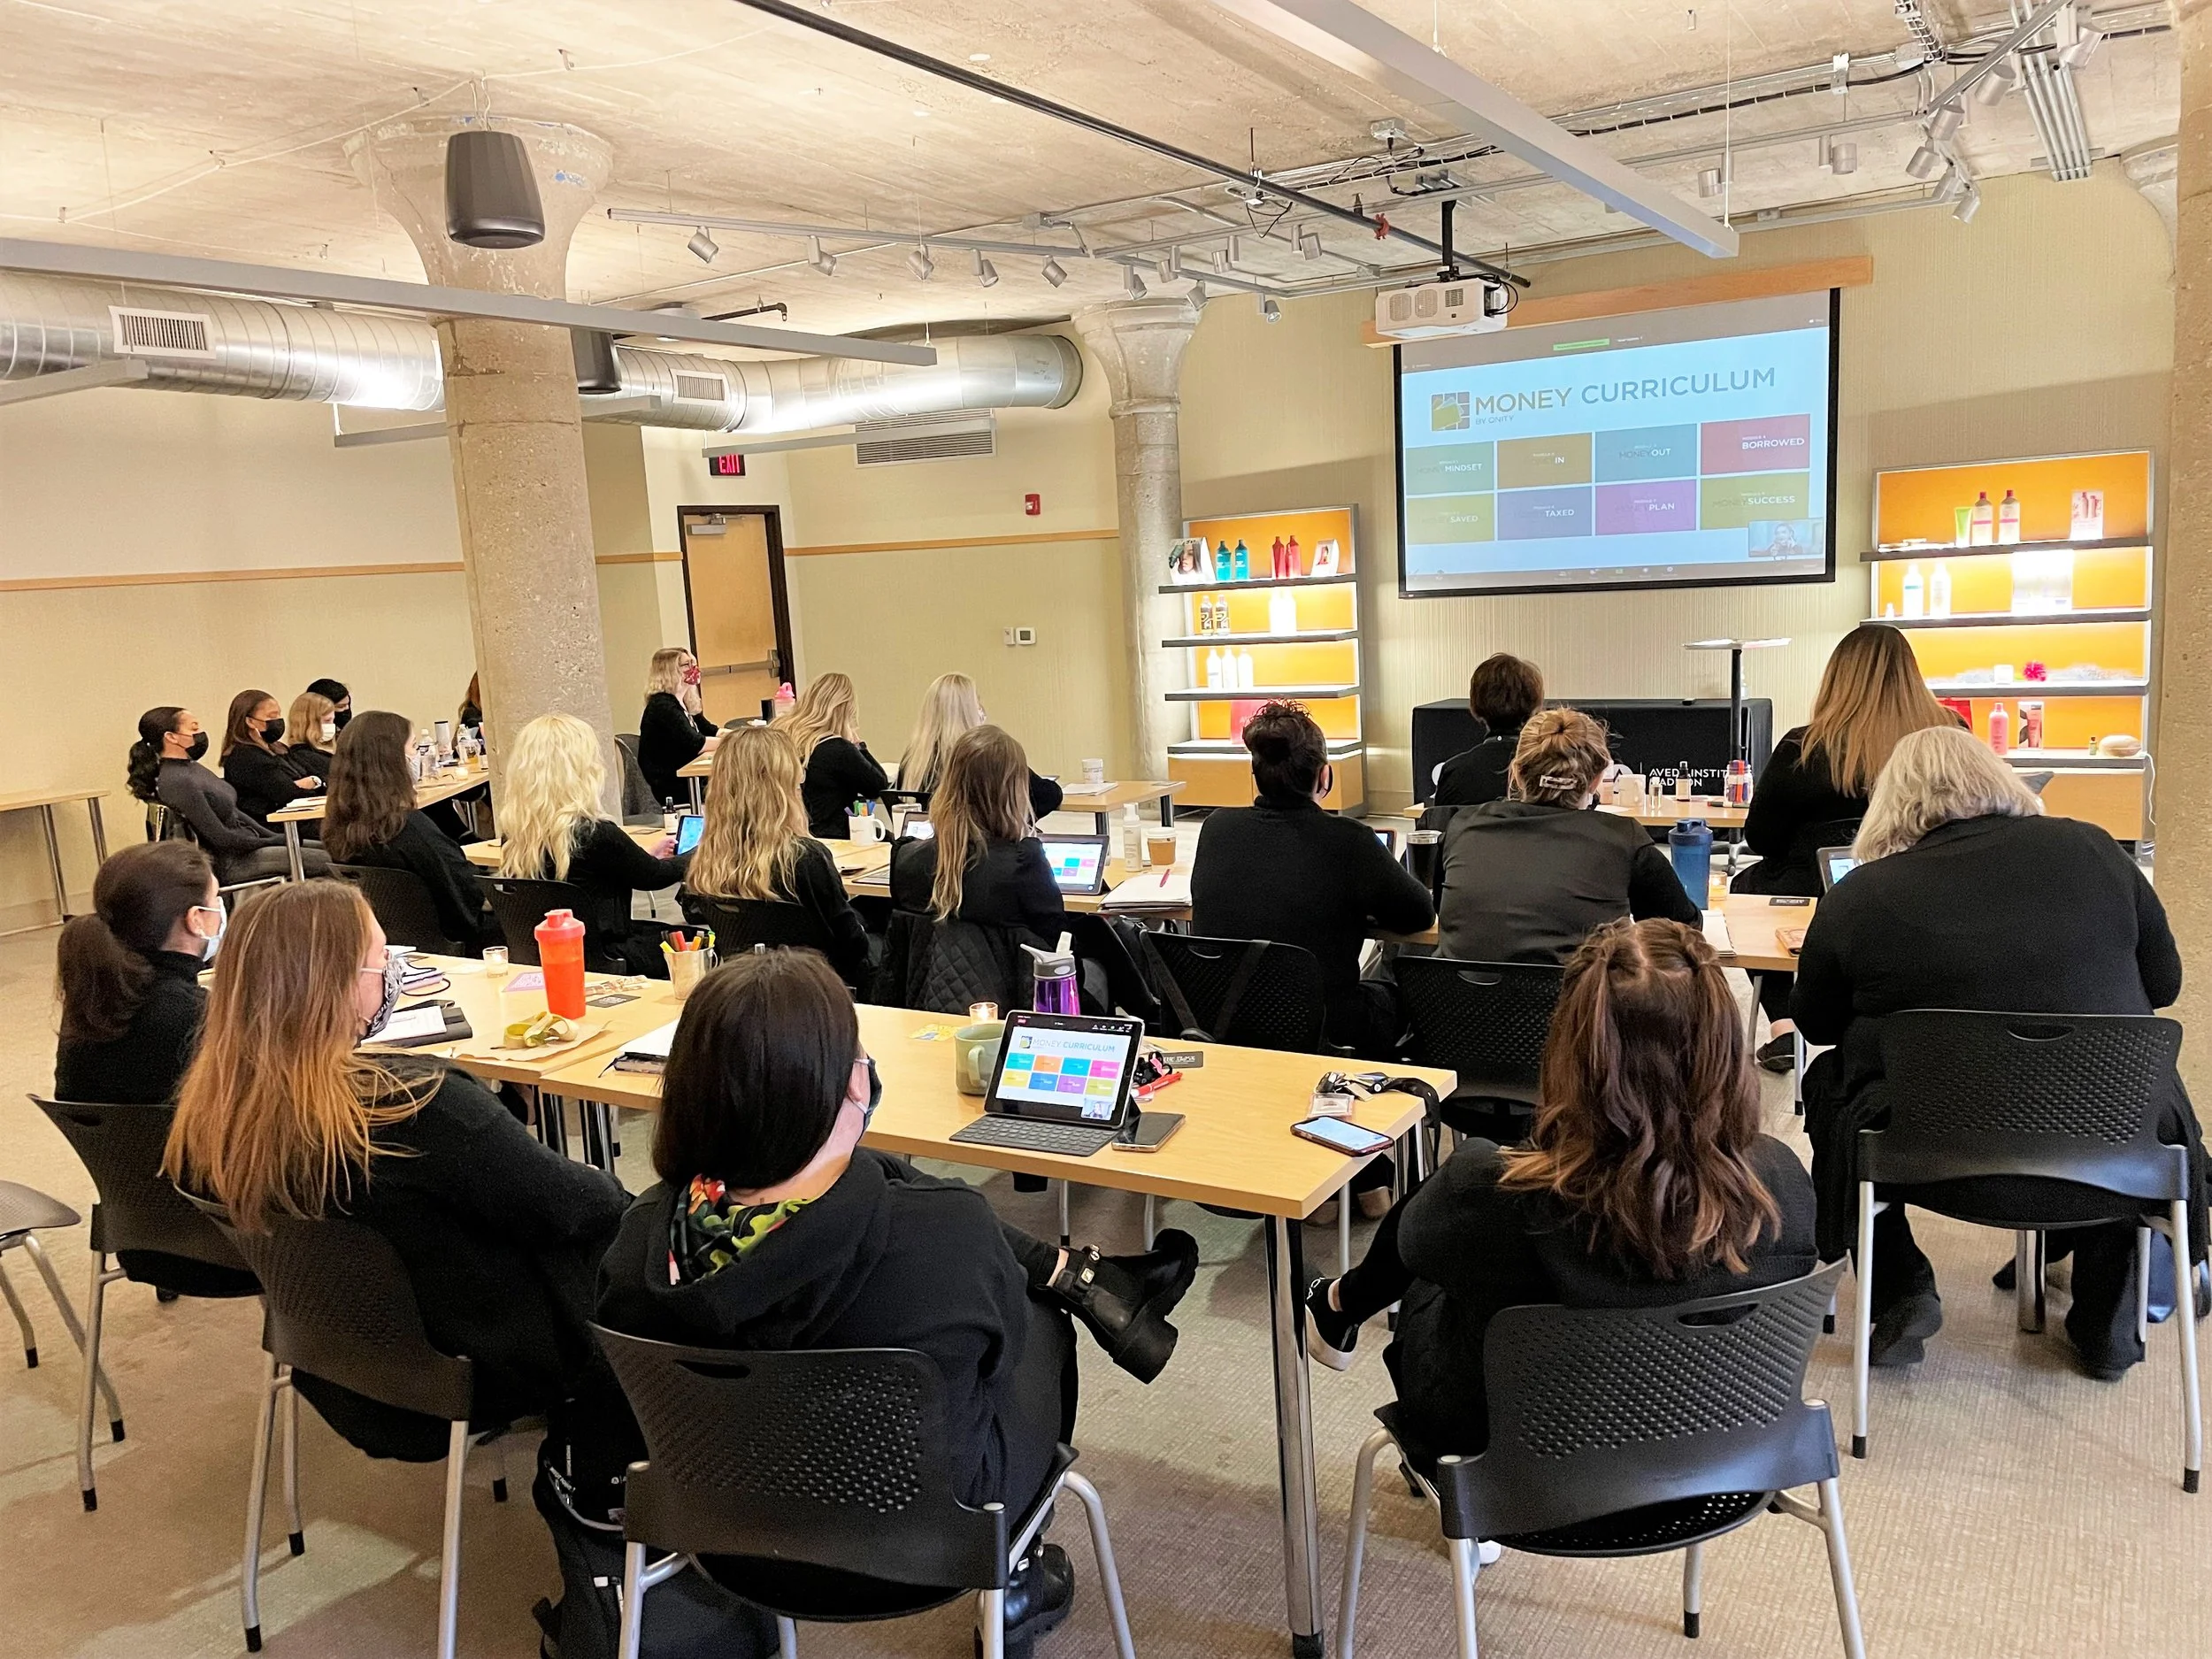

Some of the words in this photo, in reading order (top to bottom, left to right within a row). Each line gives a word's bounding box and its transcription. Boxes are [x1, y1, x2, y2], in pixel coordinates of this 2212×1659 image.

[1476, 388, 1572, 415] MONEY
[1581, 367, 1775, 404] CURRICULUM
[1741, 437, 1805, 449] BORROWED
[1444, 463, 1483, 472] MINDSET
[1747, 495, 1796, 505] SUCCESS
[1648, 503, 1675, 511] PLAN
[1545, 509, 1575, 518] TAXED
[1449, 515, 1479, 524] SAVED
[1649, 768, 1691, 778] AVED
[1033, 1039, 1061, 1048] MONEY
[1063, 1041, 1116, 1052] CURRICULUM
